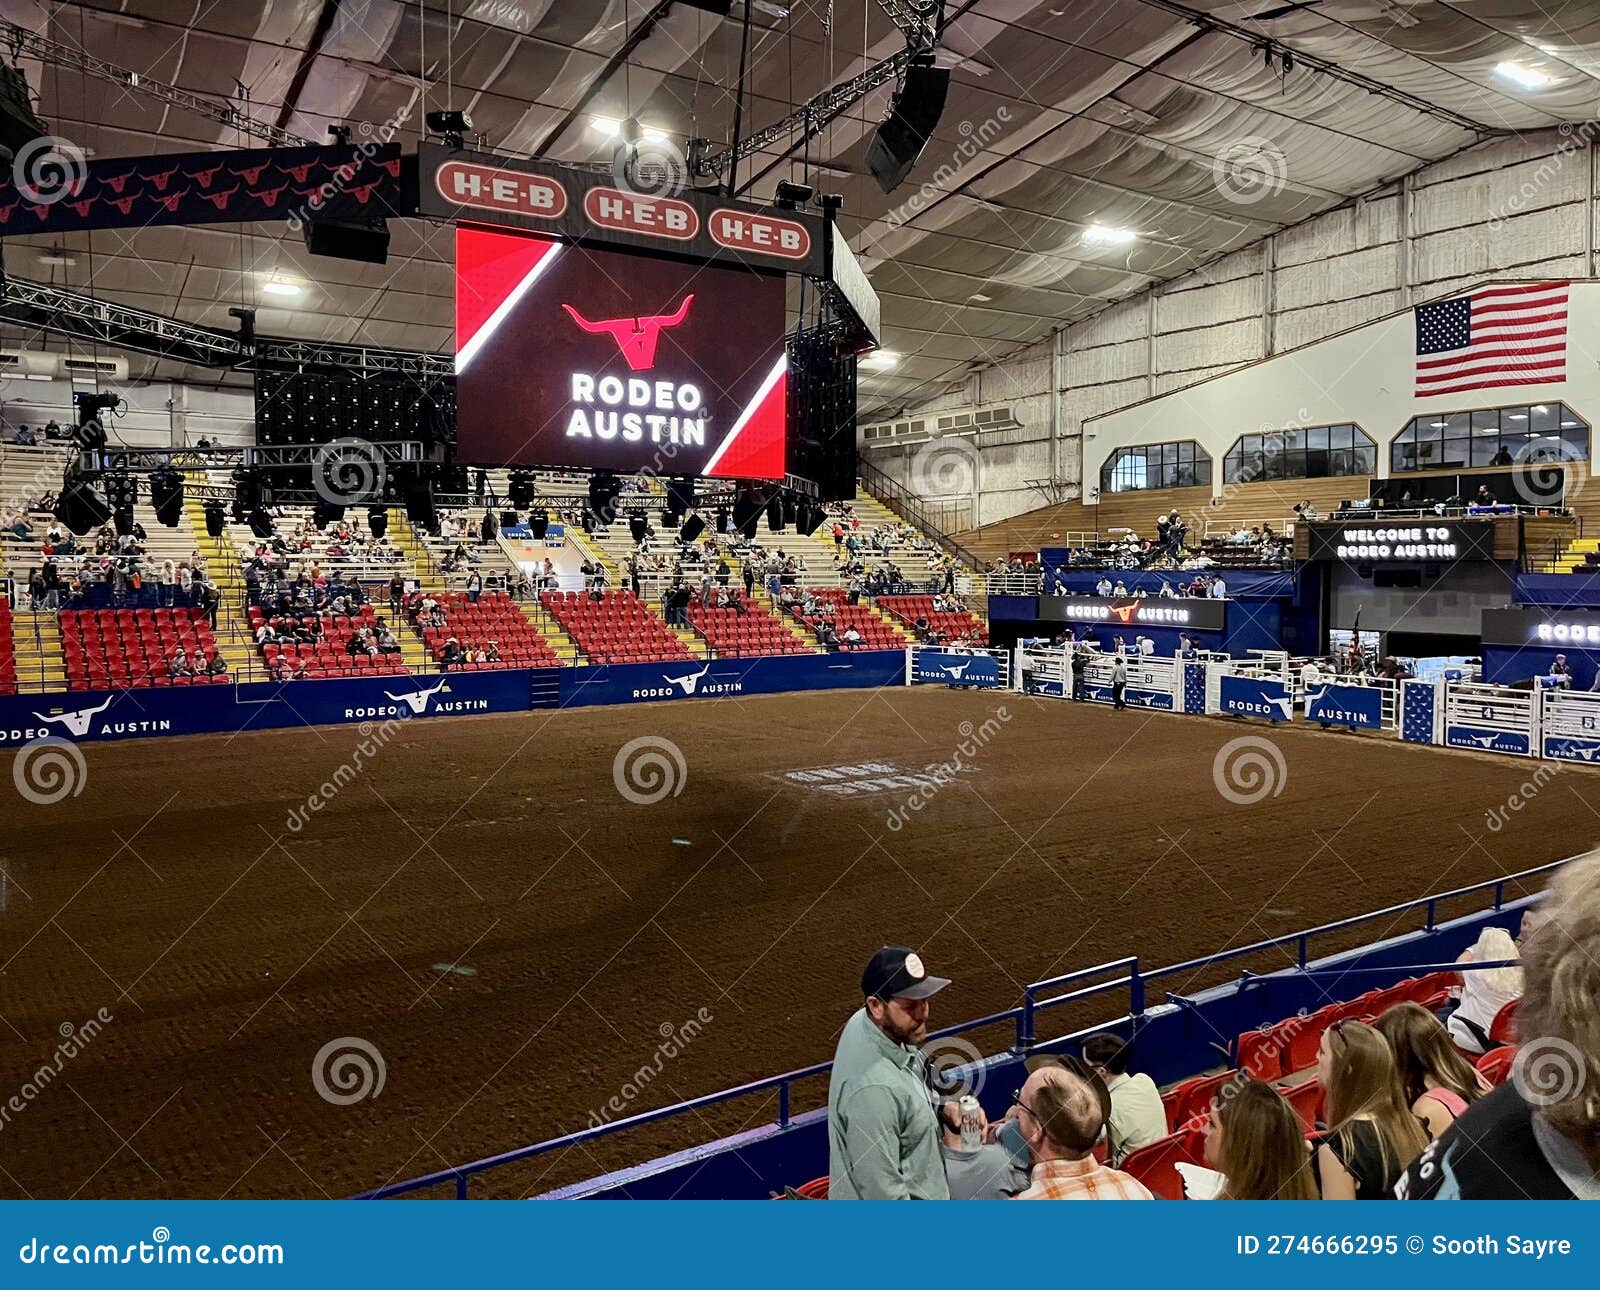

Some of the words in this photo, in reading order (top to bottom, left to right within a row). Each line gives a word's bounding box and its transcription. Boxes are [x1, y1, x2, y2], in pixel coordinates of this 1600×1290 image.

[572, 373, 701, 412] RODEO
[567, 408, 705, 446] AUSTIN
[1343, 528, 1421, 542] WELCOME
[1426, 527, 1449, 540] TO
[1337, 544, 1390, 557] RODEO
[1394, 543, 1456, 557] AUSTIN
[1066, 605, 1109, 618] RODEO
[1137, 607, 1189, 622] AUSTIN
[633, 687, 673, 698] RODEO
[701, 682, 742, 693] AUSTIN
[345, 705, 397, 718] RODEO
[435, 700, 488, 712] AUSTIN
[1228, 700, 1271, 714] RODEO
[1317, 708, 1368, 723] AUSTIN
[1484, 707, 1492, 719] 4
[101, 719, 171, 734] AUSTIN
